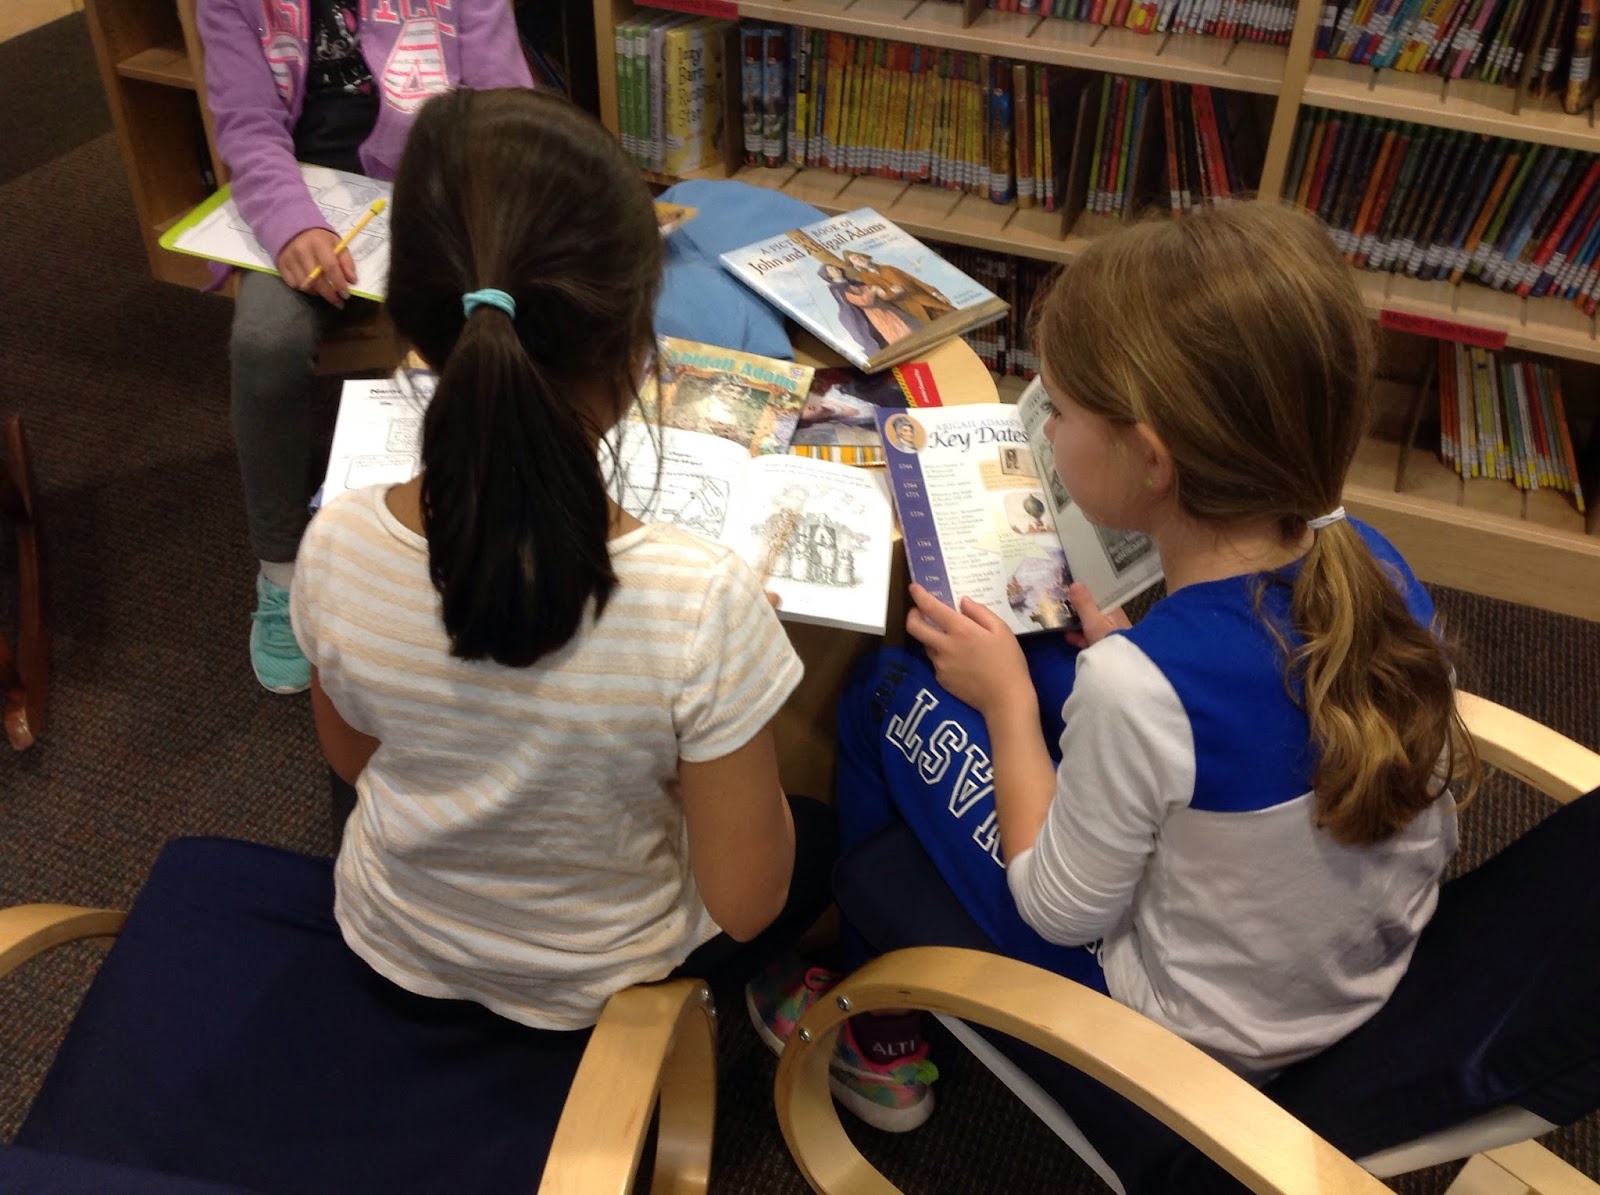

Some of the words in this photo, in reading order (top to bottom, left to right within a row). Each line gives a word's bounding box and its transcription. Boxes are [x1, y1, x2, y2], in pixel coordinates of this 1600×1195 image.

[748, 256, 784, 277] John
[782, 248, 807, 264] and
[802, 233, 848, 256] Abigail
[846, 222, 888, 242] Adams
[761, 248, 770, 256] A
[810, 225, 840, 239] BOOK
[741, 362, 798, 392] Adams
[928, 430, 970, 453] Key
[974, 426, 1030, 445] Dates
[935, 420, 977, 434] ABIGAIL
